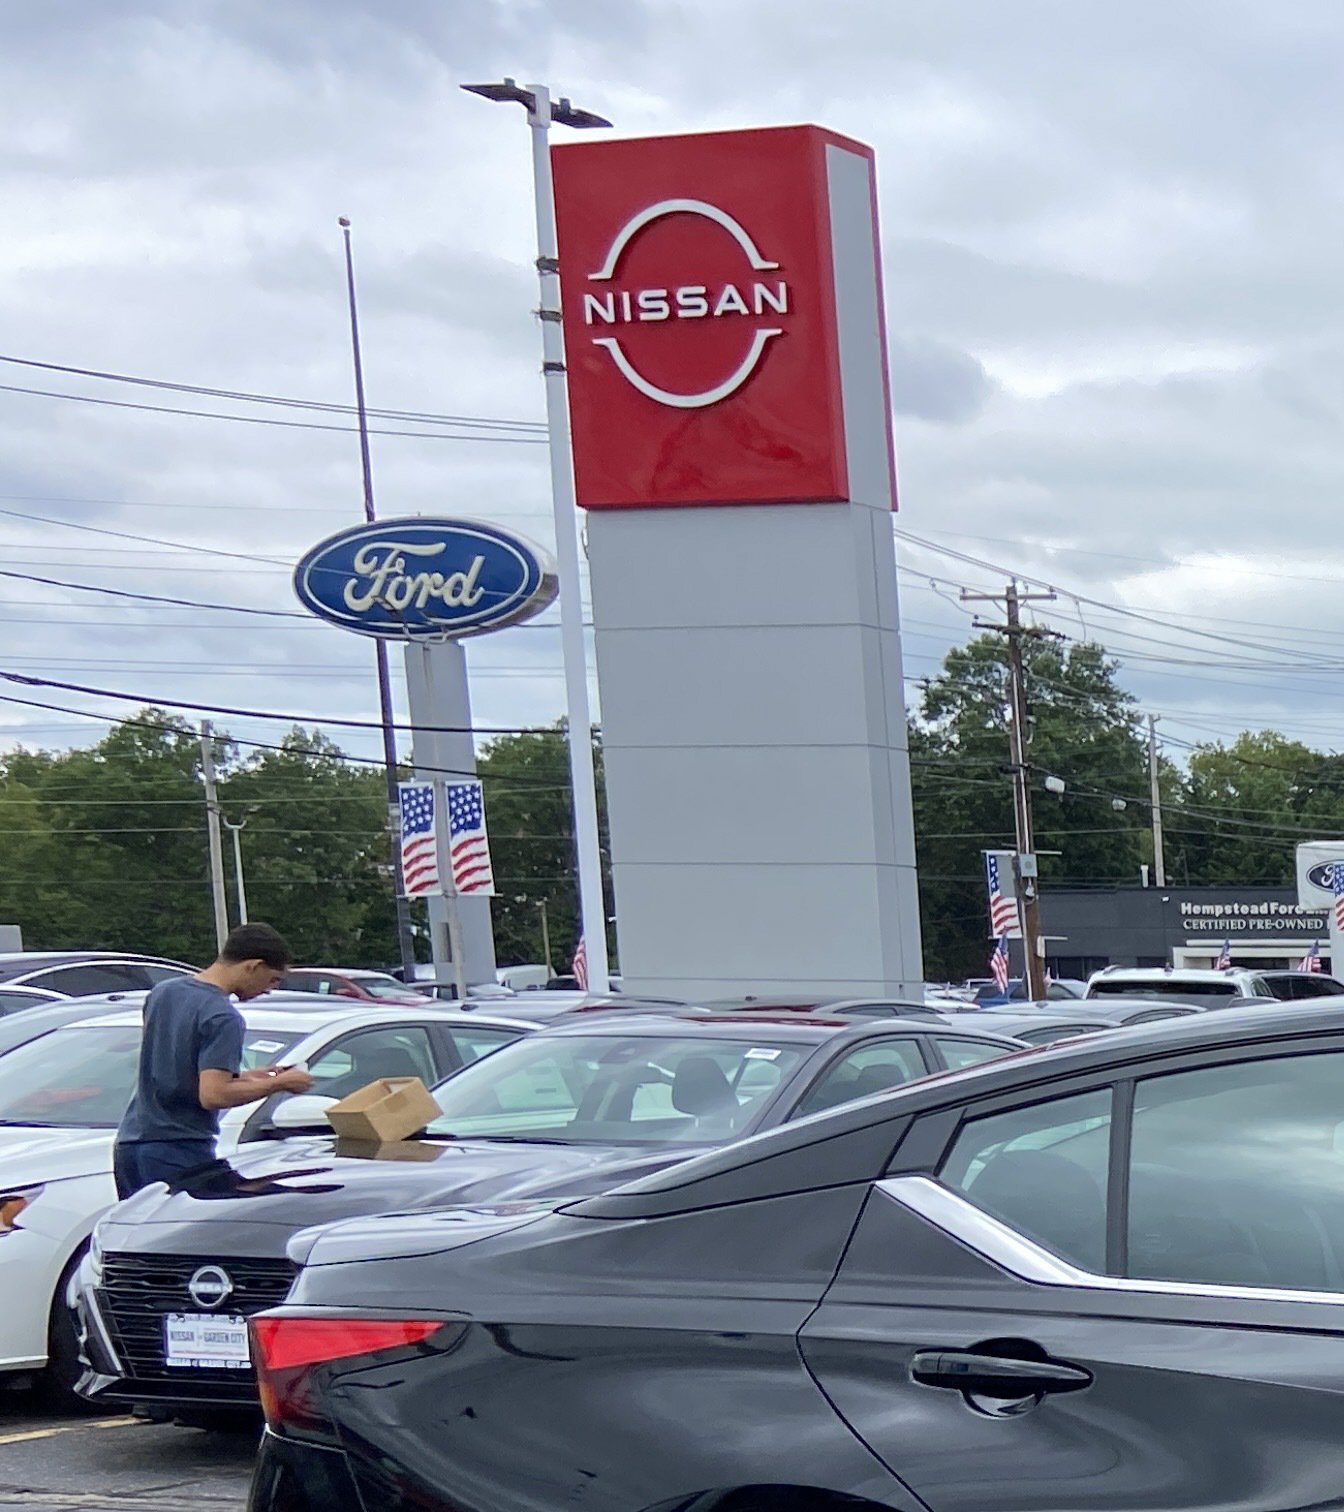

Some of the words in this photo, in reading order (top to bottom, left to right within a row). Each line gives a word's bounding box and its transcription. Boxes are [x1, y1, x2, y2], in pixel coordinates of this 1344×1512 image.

[584, 281, 788, 325] NISSAN
[343, 541, 485, 613] Ford
[1181, 902, 1268, 917] Hempstead
[1183, 919, 1246, 930] CERTIFIED
[1249, 919, 1324, 930] PRE-OWNED
